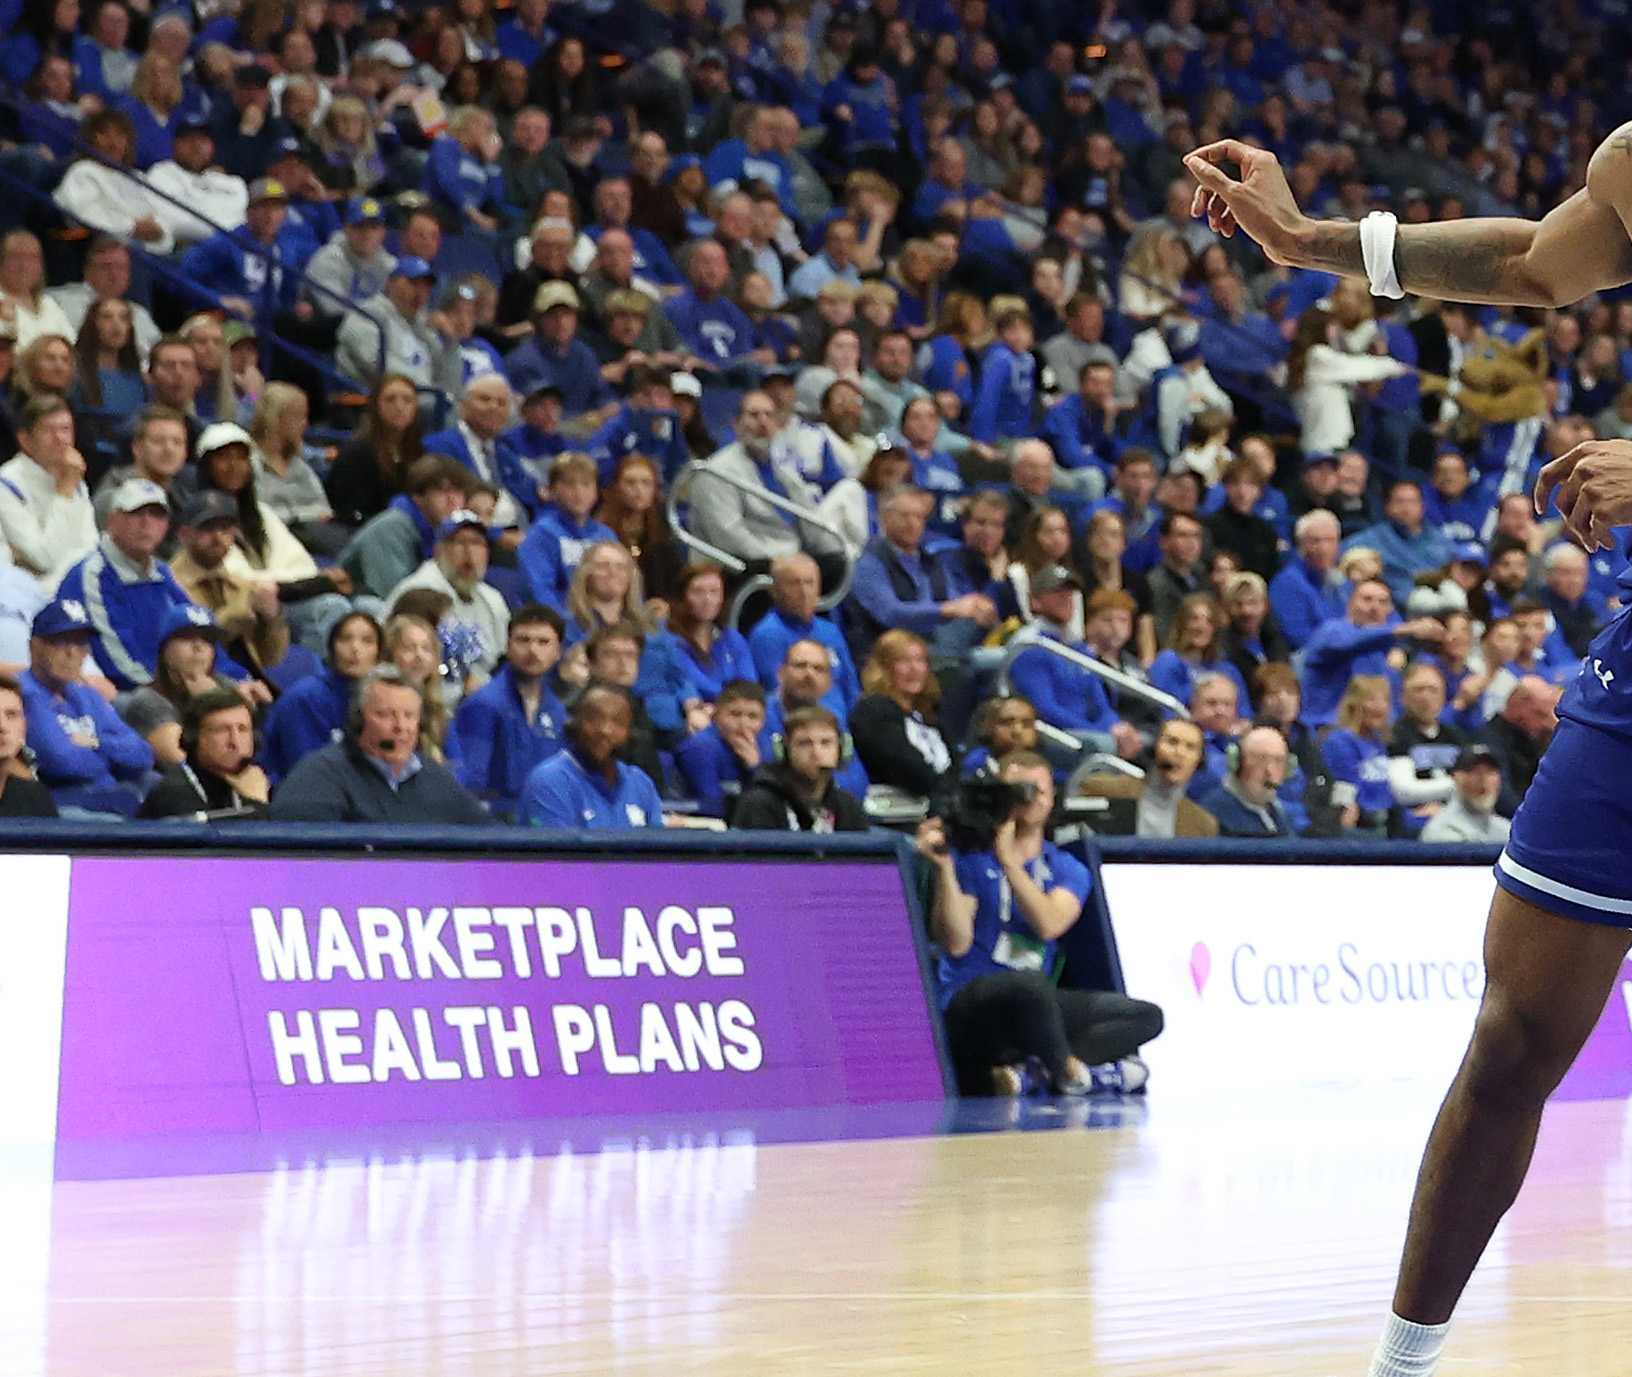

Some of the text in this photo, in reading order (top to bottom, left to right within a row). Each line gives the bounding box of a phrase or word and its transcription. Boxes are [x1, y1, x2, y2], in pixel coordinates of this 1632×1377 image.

[251, 905, 745, 981] MARKETPLACE
[1231, 943, 1482, 1009] CareSource
[268, 999, 764, 1085] HEALTH PLANS
